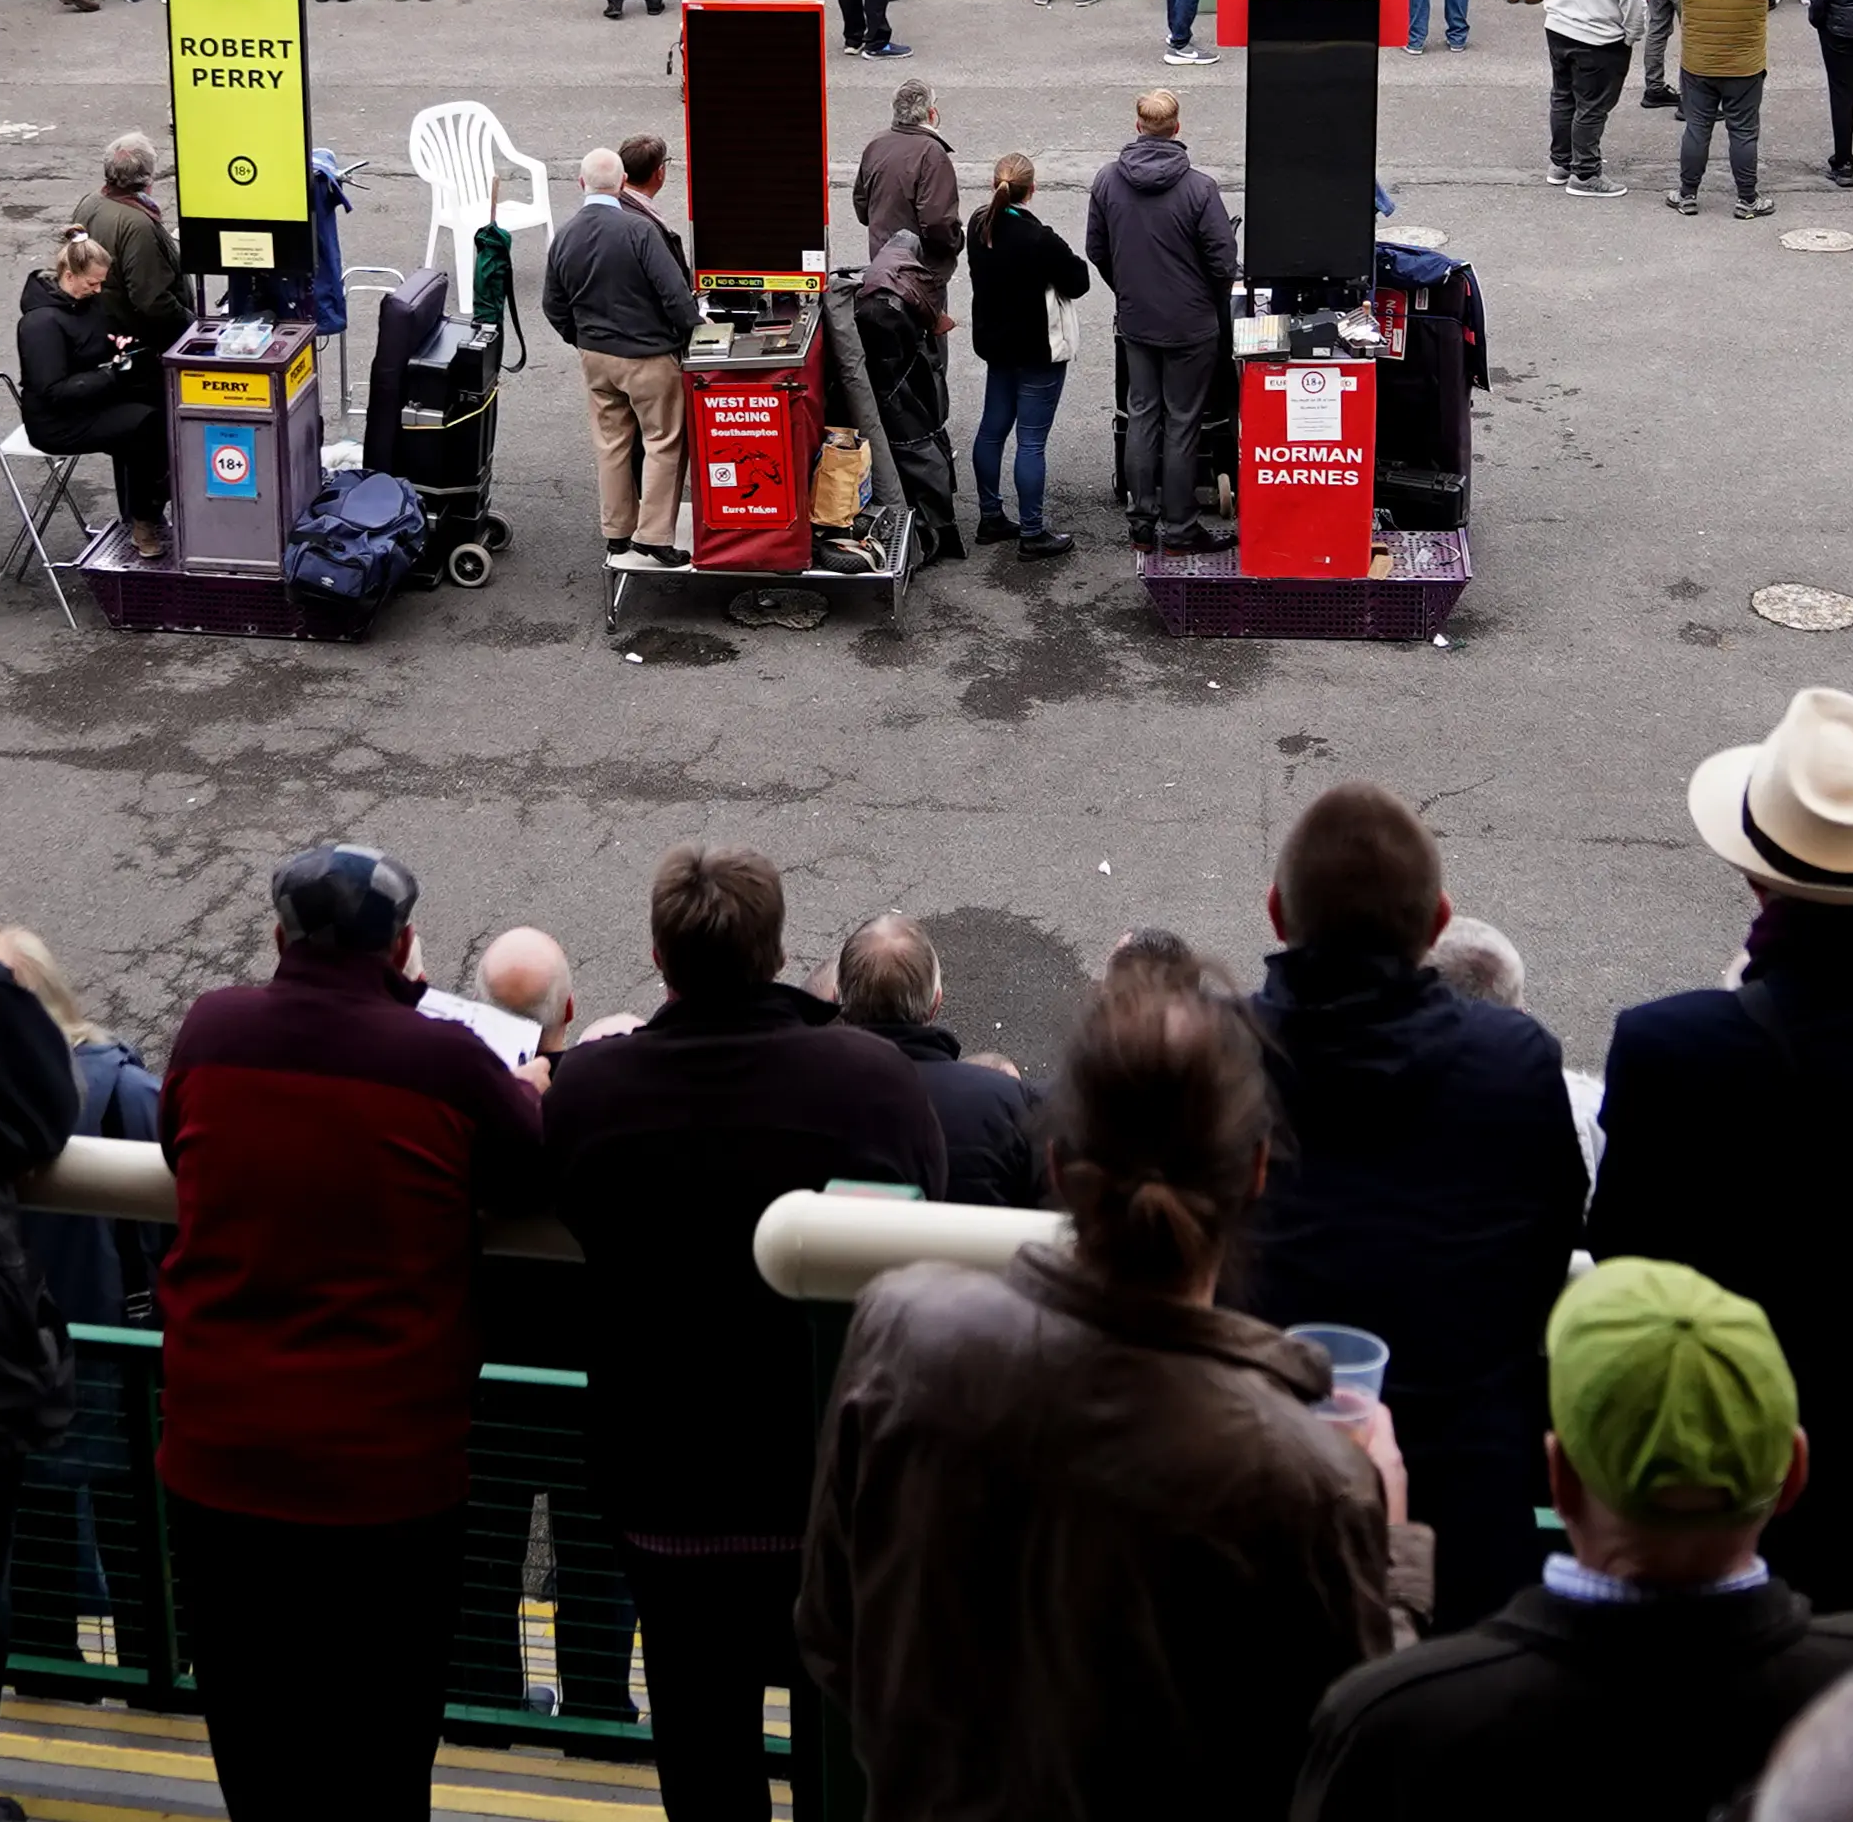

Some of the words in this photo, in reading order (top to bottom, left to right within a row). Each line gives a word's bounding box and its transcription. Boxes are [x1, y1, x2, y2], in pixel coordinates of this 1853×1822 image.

[180, 37, 293, 59] ROBERT
[192, 67, 284, 89] PERRY
[234, 166, 251, 177] 18+
[202, 380, 250, 392] PERRY
[1305, 378, 1323, 386] 18+
[704, 396, 745, 408] WEST
[749, 396, 779, 408] END
[715, 411, 771, 423] RACING
[710, 428, 779, 438] Southampton
[1254, 446, 1363, 464] NORMAN
[217, 458, 244, 470] 18+
[1257, 469, 1359, 485] BARNES
[722, 505, 746, 514] Euro
[747, 505, 778, 514] Taken
